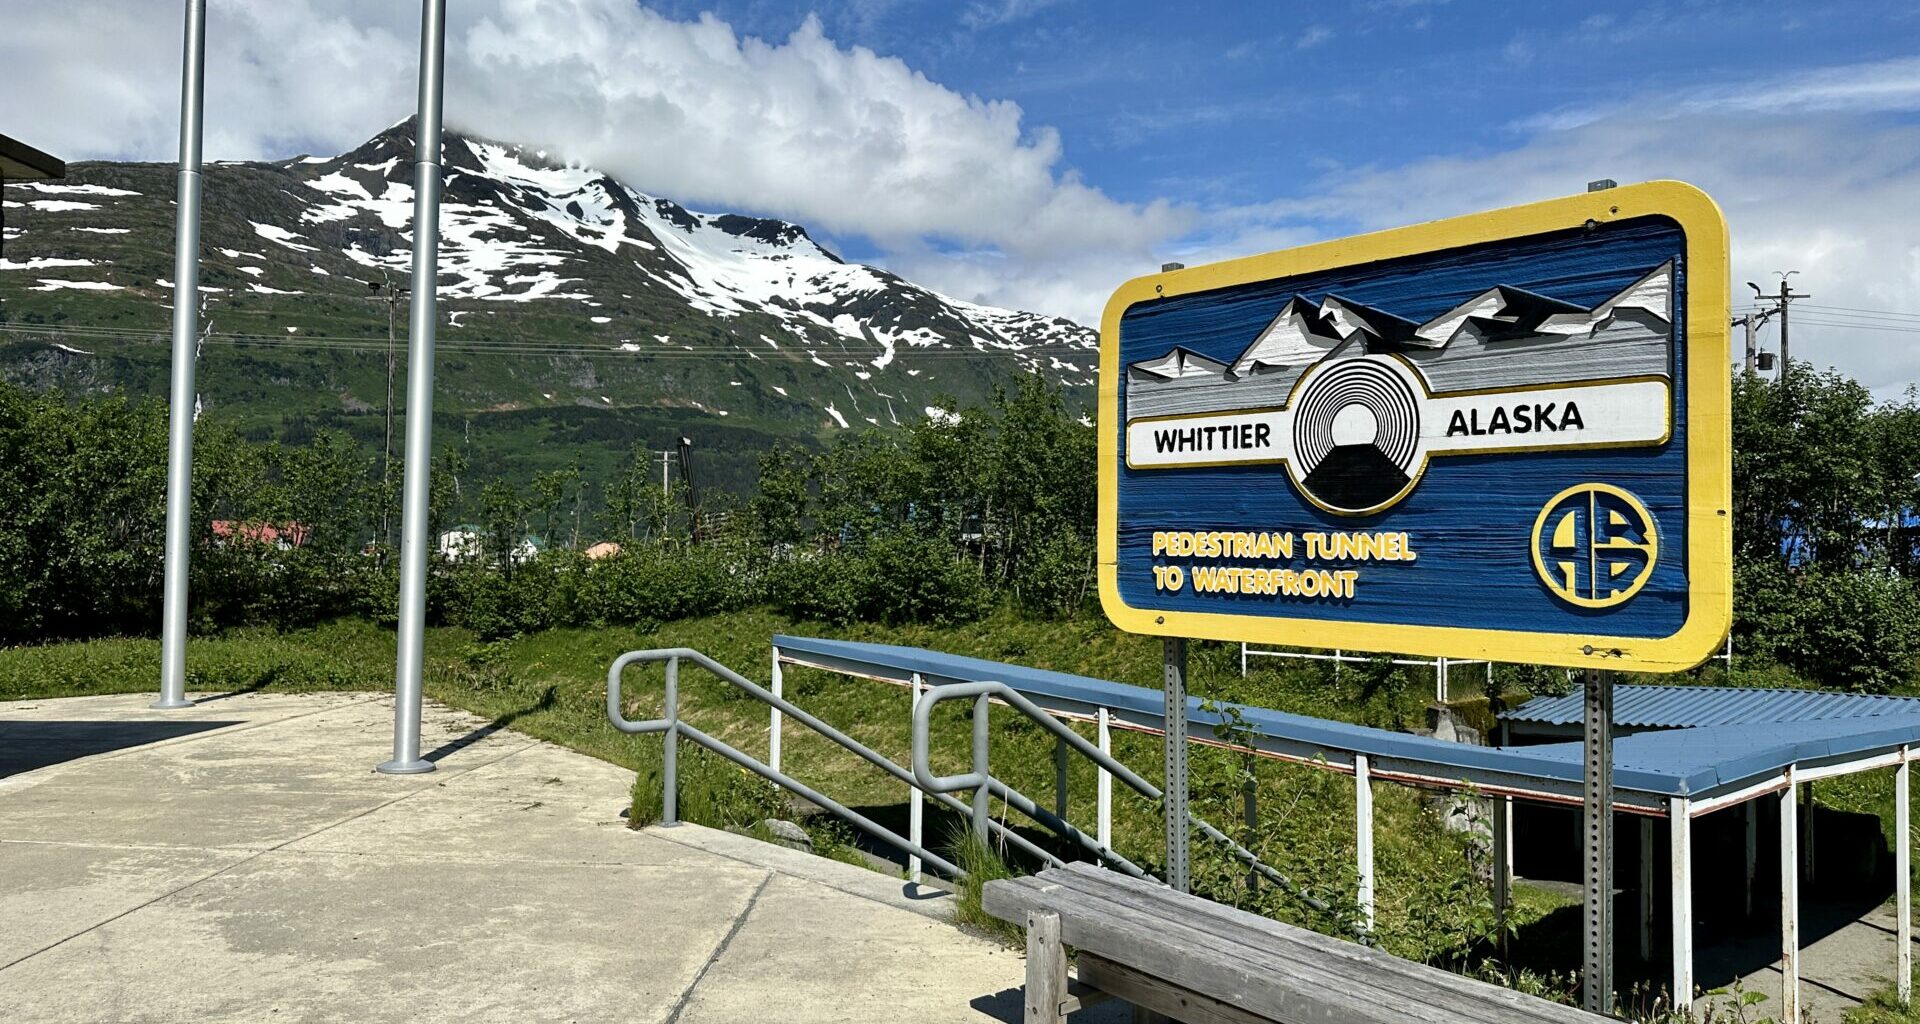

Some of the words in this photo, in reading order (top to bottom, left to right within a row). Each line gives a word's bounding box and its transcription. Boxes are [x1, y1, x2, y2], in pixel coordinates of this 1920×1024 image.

[1154, 423, 1270, 453] WHITTIER
[1446, 401, 1584, 437] ALASKA
[1152, 531, 1293, 559] PEDESTRIAN
[1302, 531, 1417, 561] TUNNEL
[1152, 565, 1184, 591] TO
[1191, 566, 1359, 599] WATERFRONT
